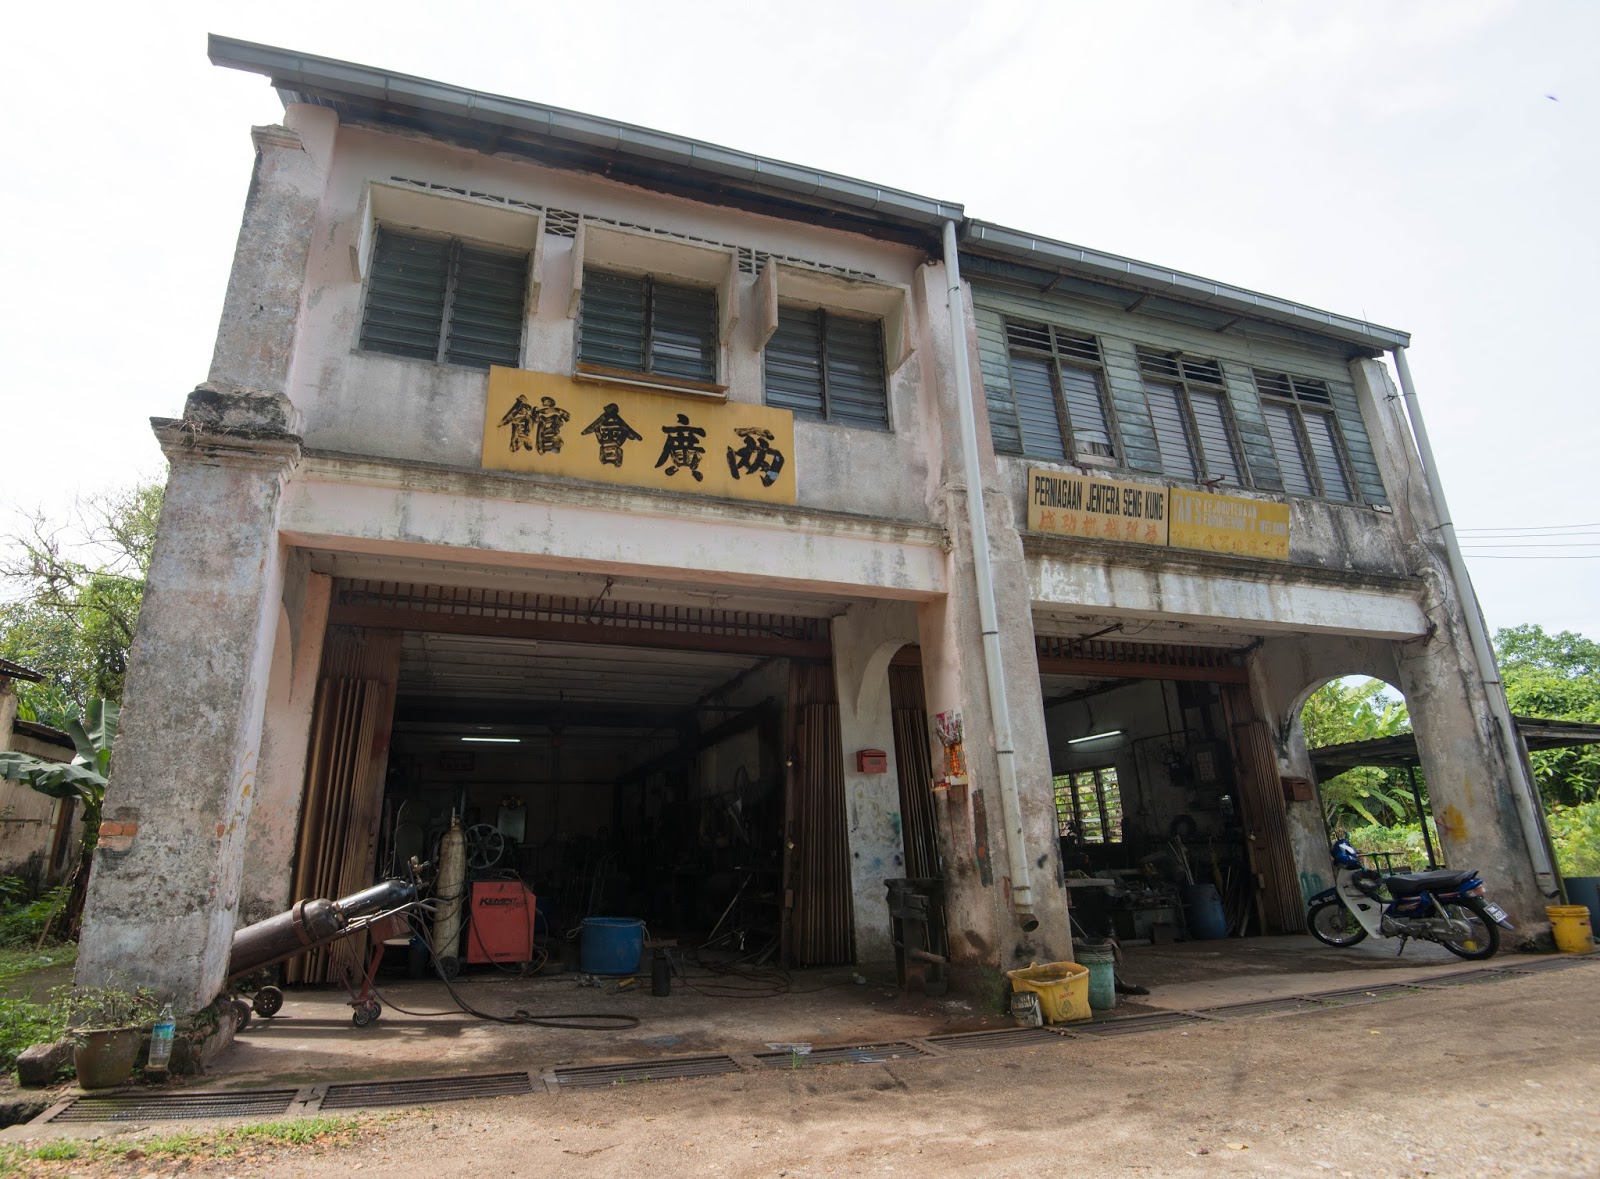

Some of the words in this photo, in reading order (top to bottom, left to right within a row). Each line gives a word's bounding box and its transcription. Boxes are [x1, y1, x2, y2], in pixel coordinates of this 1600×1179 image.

[1034, 475, 1083, 511] PERNIAGAAN
[1086, 482, 1120, 516] JENTERA
[1123, 488, 1142, 518] SENG
[1145, 490, 1164, 521] KUNG
